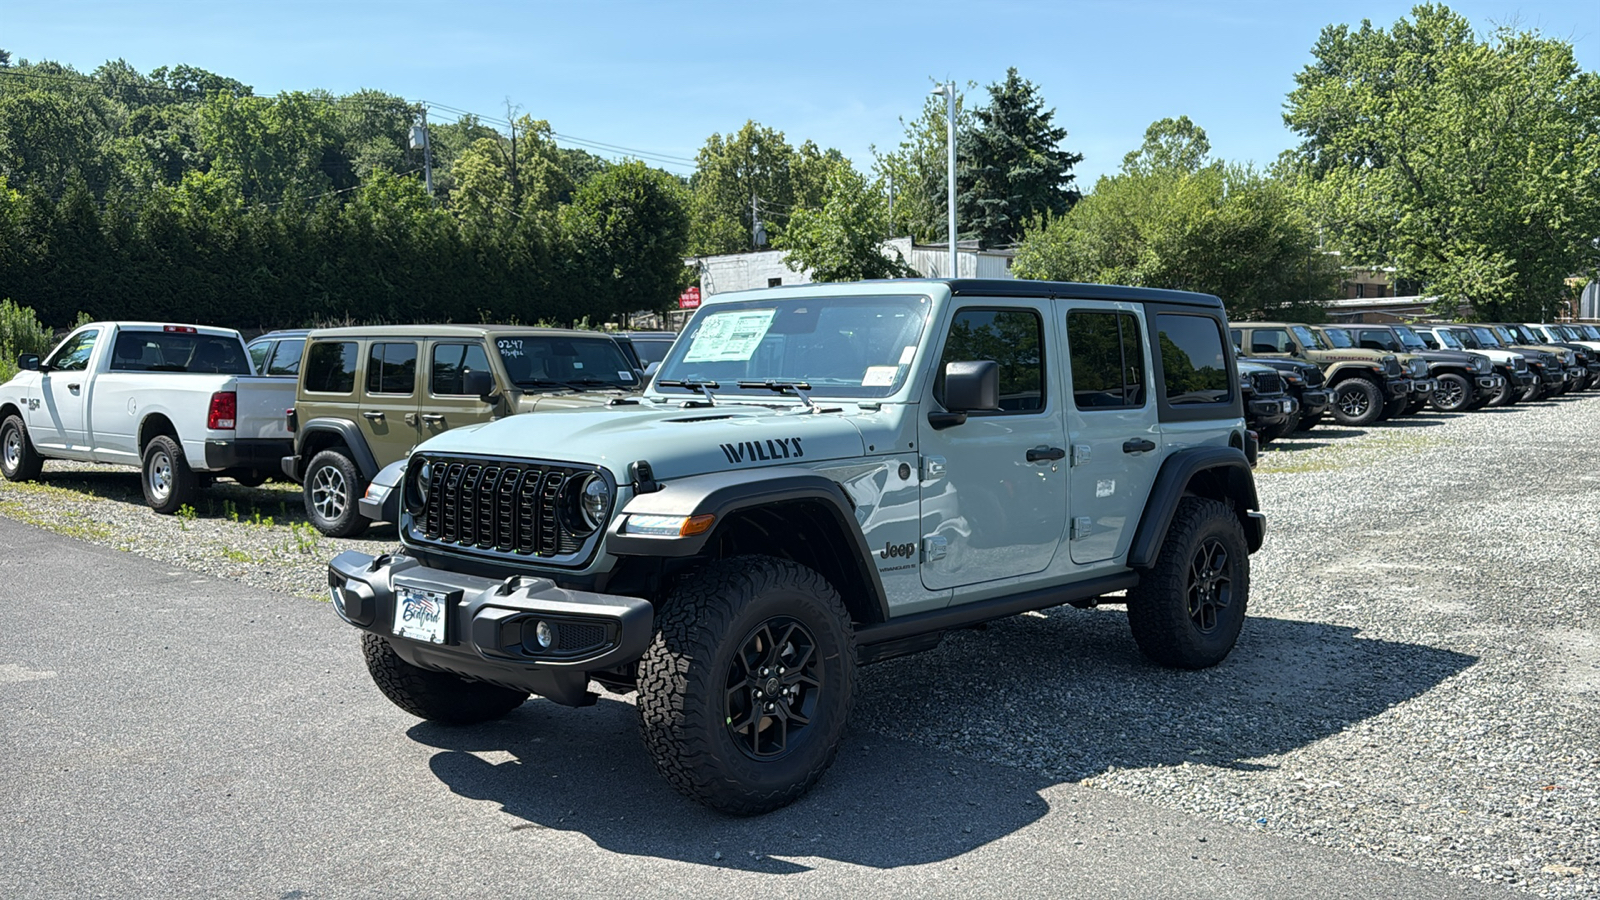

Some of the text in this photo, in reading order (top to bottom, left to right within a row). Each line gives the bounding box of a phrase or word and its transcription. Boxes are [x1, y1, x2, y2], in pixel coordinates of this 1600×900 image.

[497, 339, 523, 349] 0247
[719, 437, 804, 464] WILLYS
[880, 541, 916, 559] Jeep
[879, 564, 911, 573] WRANGLER
[402, 597, 441, 627] Bedford
